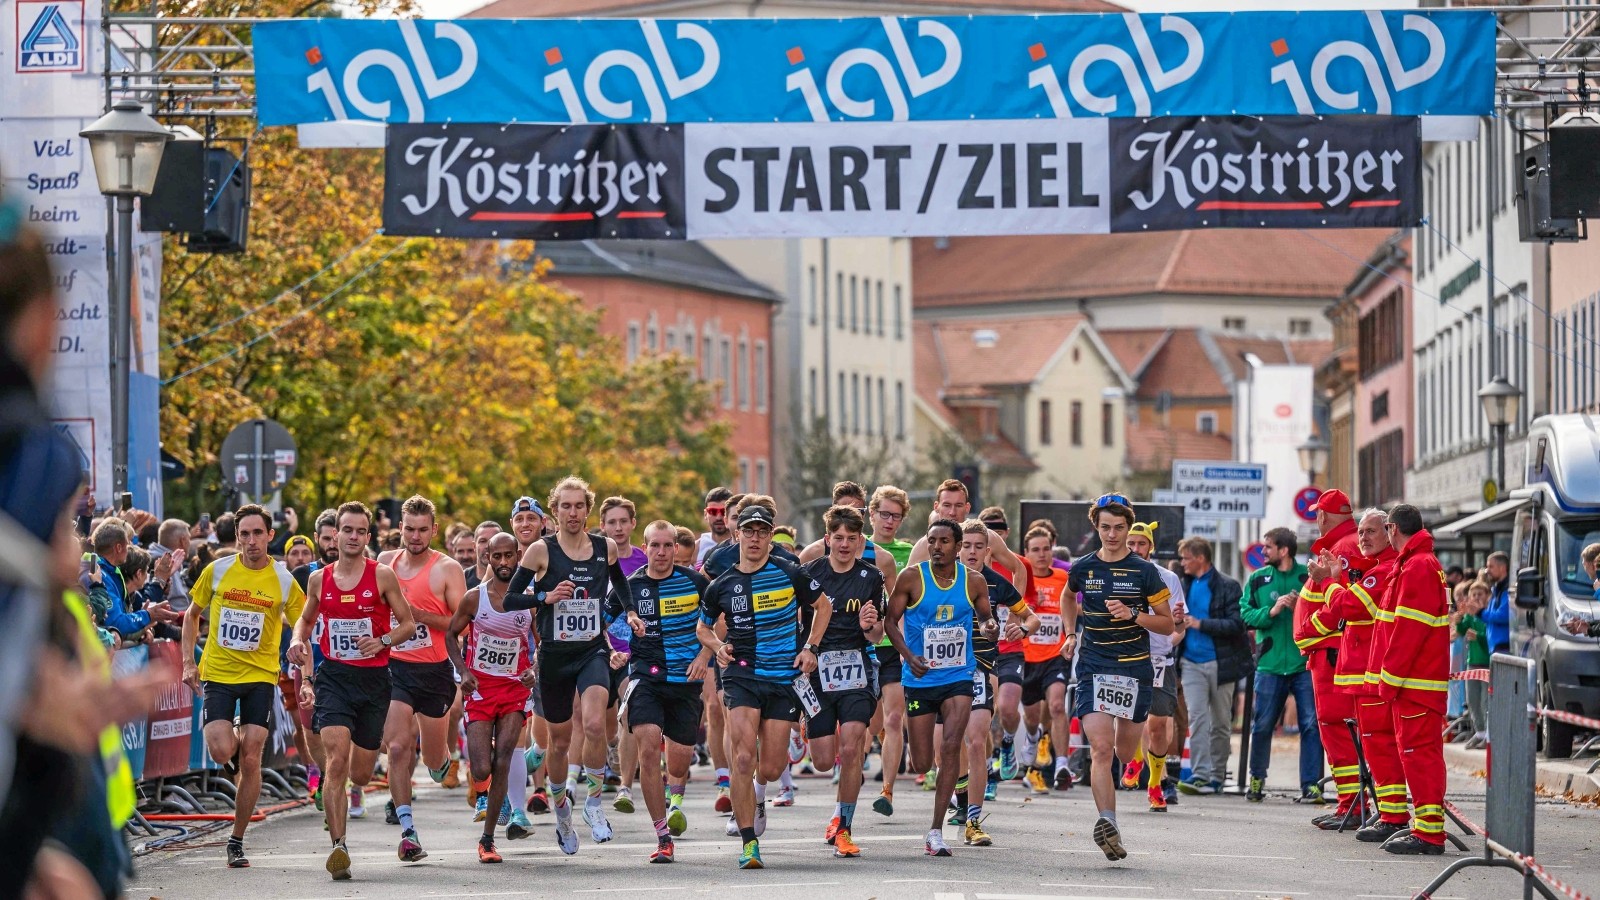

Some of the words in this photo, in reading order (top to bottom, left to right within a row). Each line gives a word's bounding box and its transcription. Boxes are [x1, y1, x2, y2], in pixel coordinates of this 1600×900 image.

[27, 52, 74, 66] ALDI
[34, 139, 73, 157] Viel
[402, 137, 668, 217] Köstritzer
[1127, 130, 1403, 210] Köstritzer
[27, 172, 80, 195] Spaß
[29, 205, 80, 222] beim
[46, 237, 87, 255] adt-
[57, 336, 84, 353] DI.
[1176, 482, 1226, 495] Laufzeit
[1230, 485, 1262, 496] unter
[1190, 498, 1212, 511] 45
[1218, 499, 1249, 512] min
[557, 615, 596, 632] 1901
[1034, 625, 1060, 637] 904
[221, 622, 261, 643] 1092
[331, 634, 371, 651] 155
[926, 642, 965, 659] 1907
[478, 647, 517, 666] 2867
[821, 664, 863, 683] 1477
[1097, 687, 1134, 708] 4568
